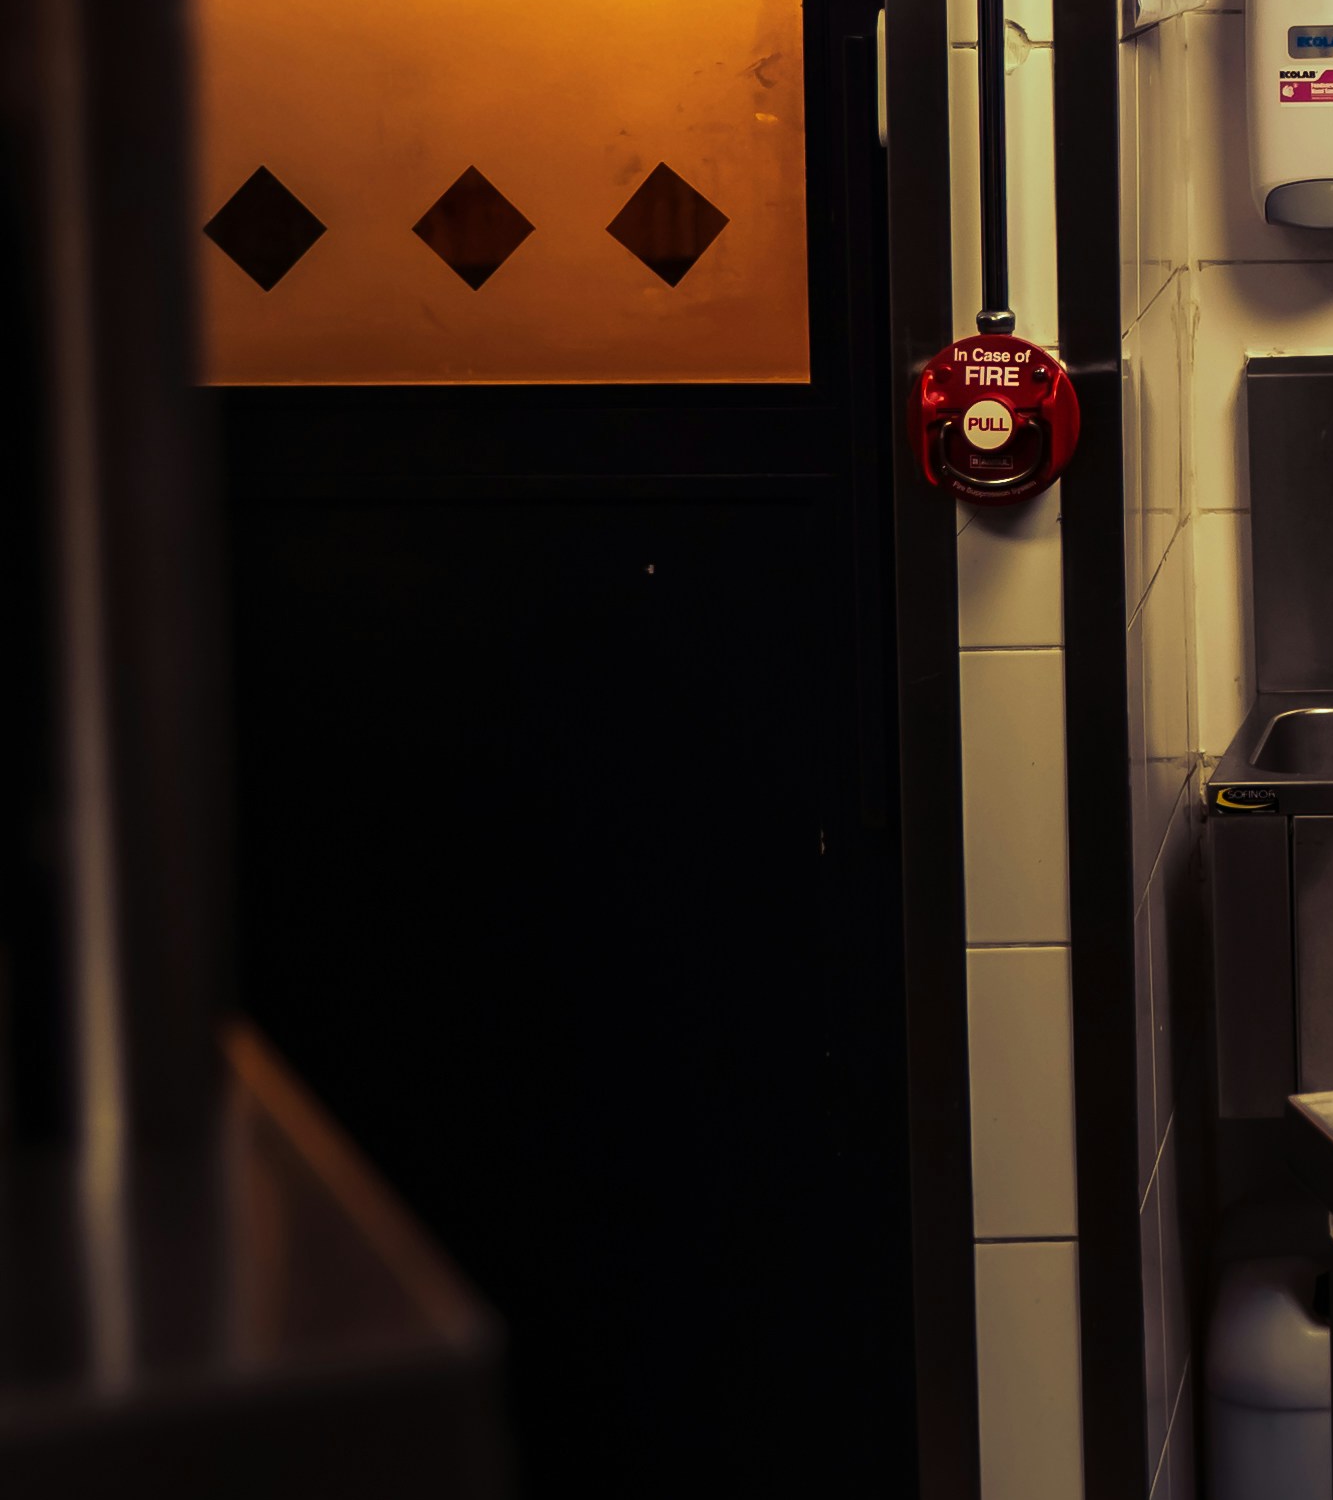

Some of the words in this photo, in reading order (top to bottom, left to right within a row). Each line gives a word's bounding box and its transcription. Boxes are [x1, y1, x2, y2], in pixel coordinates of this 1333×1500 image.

[1280, 70, 1317, 79] ECOLAB
[953, 347, 968, 362] In
[972, 347, 1011, 363] Case
[1014, 349, 1031, 364] of
[964, 365, 1020, 387] FIRE
[967, 417, 1010, 432] PULL
